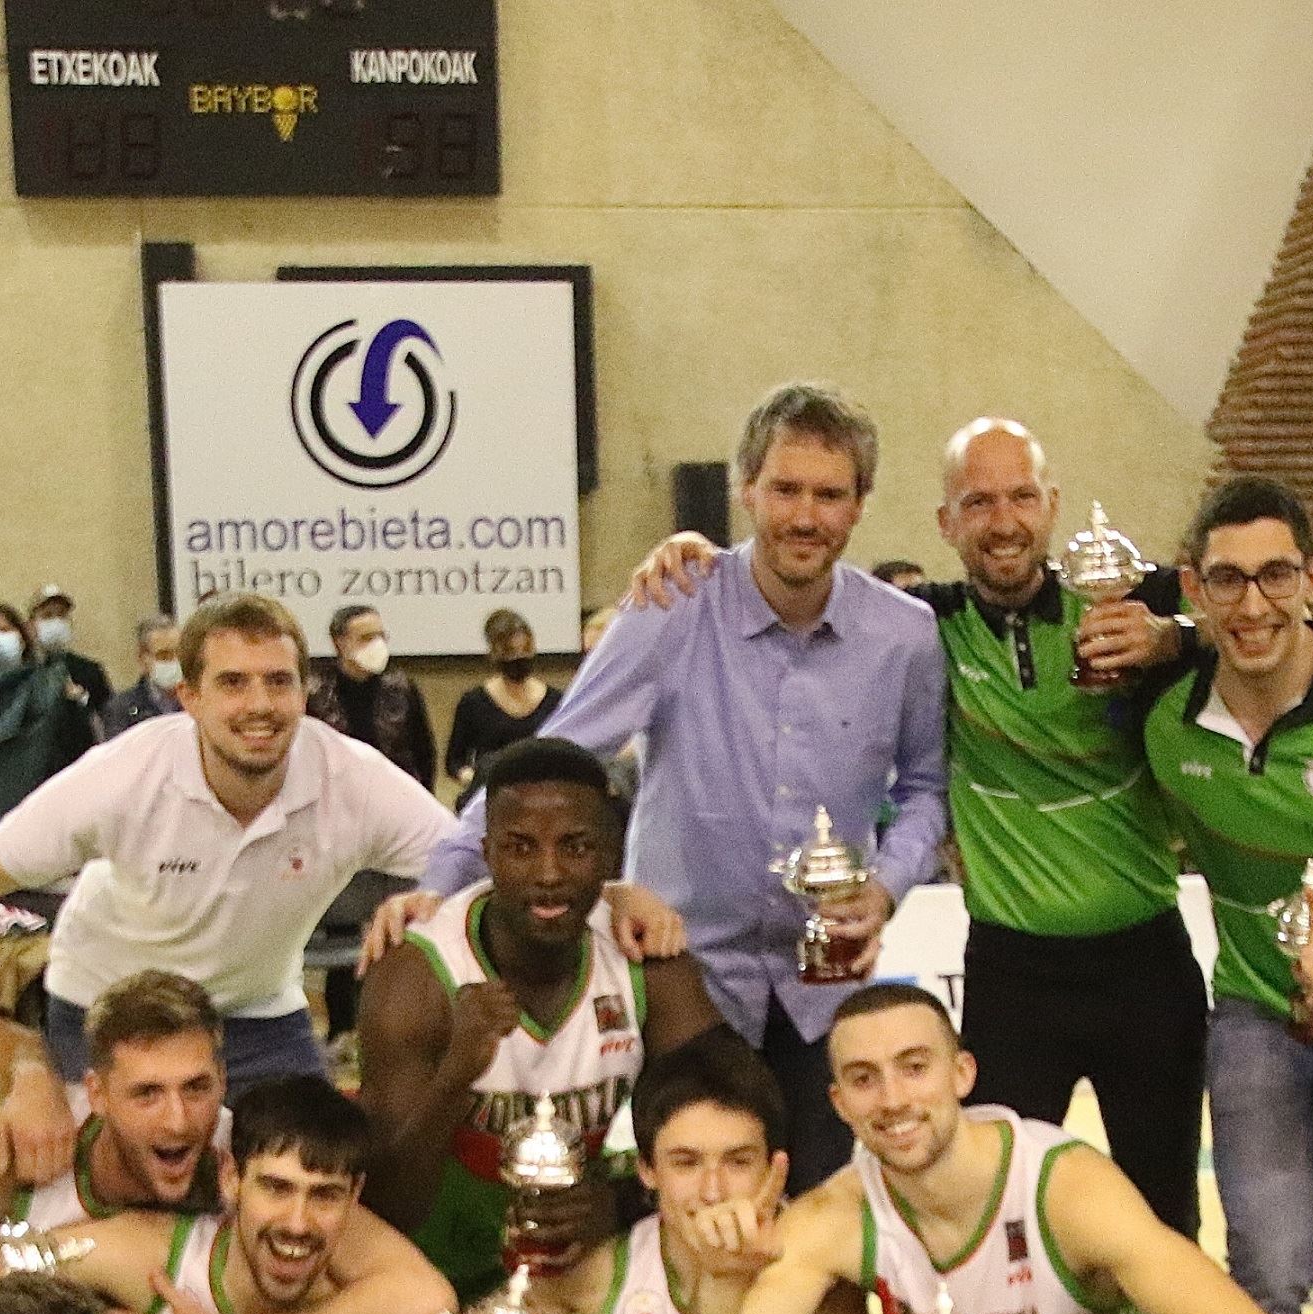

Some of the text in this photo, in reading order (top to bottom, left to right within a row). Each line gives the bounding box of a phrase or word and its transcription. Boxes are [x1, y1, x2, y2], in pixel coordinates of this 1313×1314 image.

[29, 50, 160, 86] ETXEKOAK
[350, 50, 478, 84] KANPOKOAK
[186, 507, 566, 552] amorebieta.com
[342, 560, 566, 597] zornotzan
